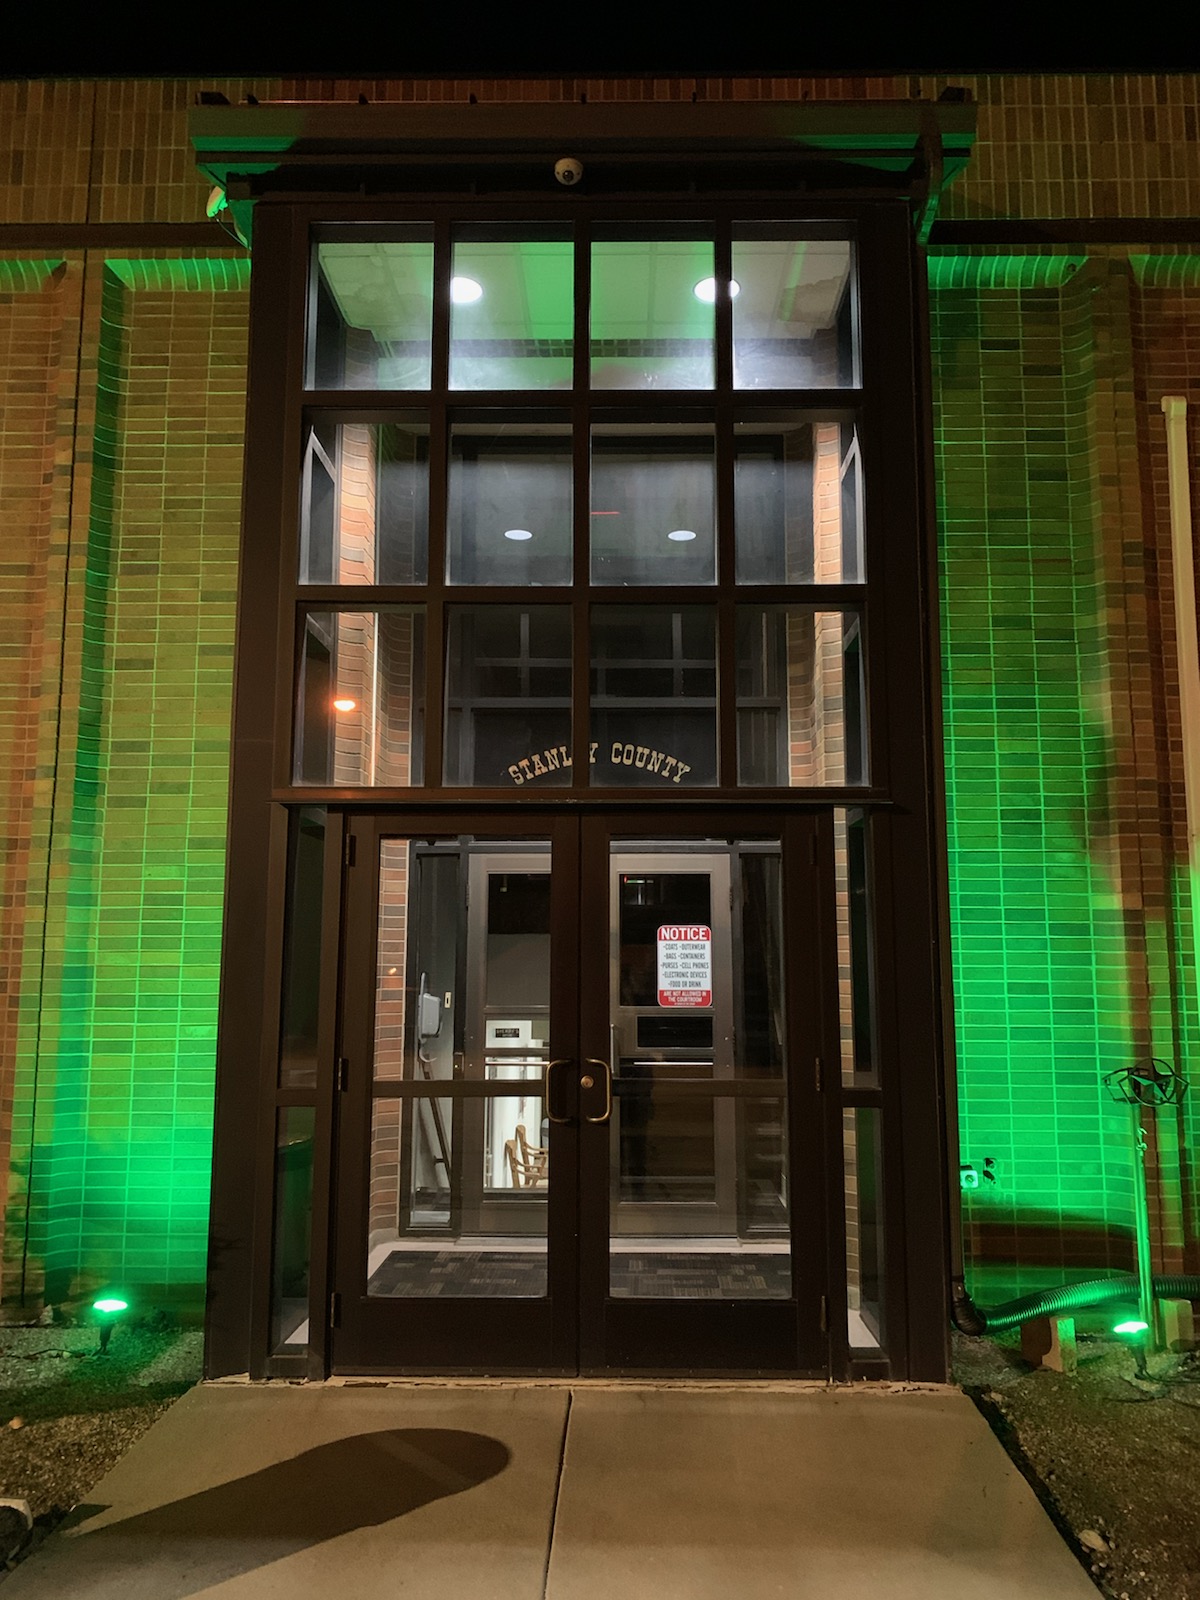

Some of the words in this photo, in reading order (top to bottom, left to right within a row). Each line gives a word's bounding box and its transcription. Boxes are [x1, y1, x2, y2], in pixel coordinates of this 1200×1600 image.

[508, 742, 599, 785] STANLY
[611, 742, 691, 784] COUNTY
[661, 927, 707, 940] NOTICE
